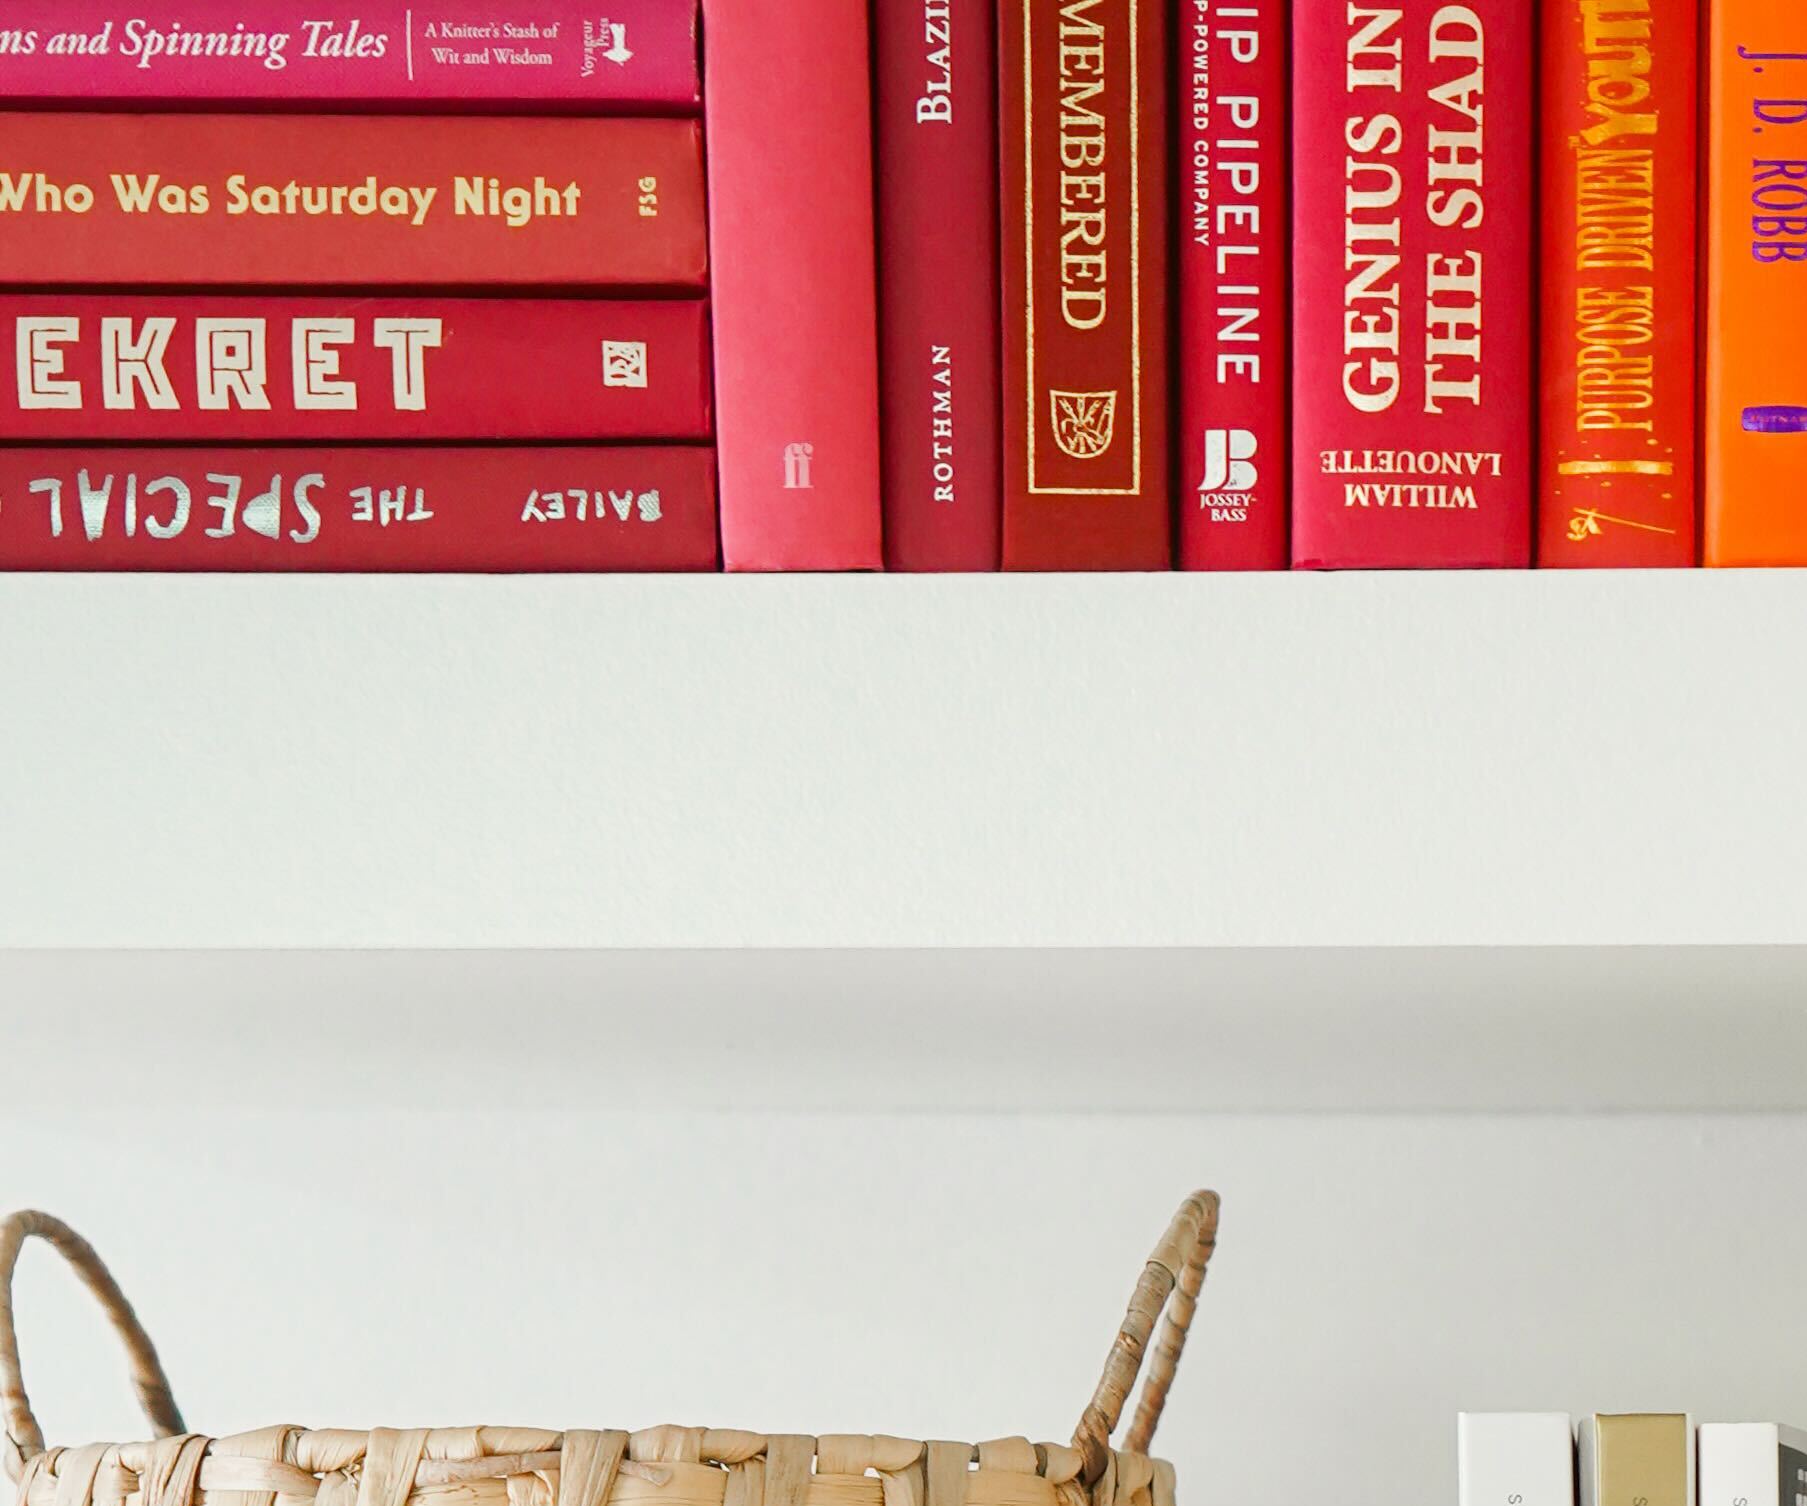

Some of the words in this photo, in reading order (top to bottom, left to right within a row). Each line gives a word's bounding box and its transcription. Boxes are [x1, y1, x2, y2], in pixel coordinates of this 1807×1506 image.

[46, 21, 113, 55] and
[118, 18, 290, 70] Spinning
[299, 18, 389, 60] Tales
[432, 47, 460, 66] Wit
[462, 48, 490, 66] and
[491, 47, 553, 66] Wisdom
[440, 20, 500, 40] Knitter's
[501, 20, 540, 40] Stash
[542, 20, 560, 40] of
[1346, 1, 1403, 93] IN
[1426, 5, 1486, 229] SHAD
[0, 173, 94, 213] Who
[110, 174, 210, 216] Was
[226, 175, 438, 227] Saturday
[454, 175, 581, 227] Night
[638, 176, 659, 218] FSG
[1193, 140, 1211, 247] COMPANY
[1216, 95, 1260, 385] PIPELINE
[1342, 114, 1403, 414] GENIUS
[1422, 249, 1483, 416] THE
[1575, 286, 1655, 433] PURPOSE
[933, 344, 955, 503] ROTHMAN
[1319, 450, 1502, 478] LANOUETTE
[28, 468, 328, 545] SPECIAL
[350, 486, 435, 528] THE
[520, 488, 664, 524] BAILEY
[1199, 492, 1257, 509] JOSSEY-
[1210, 508, 1247, 523] BASS
[1343, 483, 1478, 510] WILLIAM
